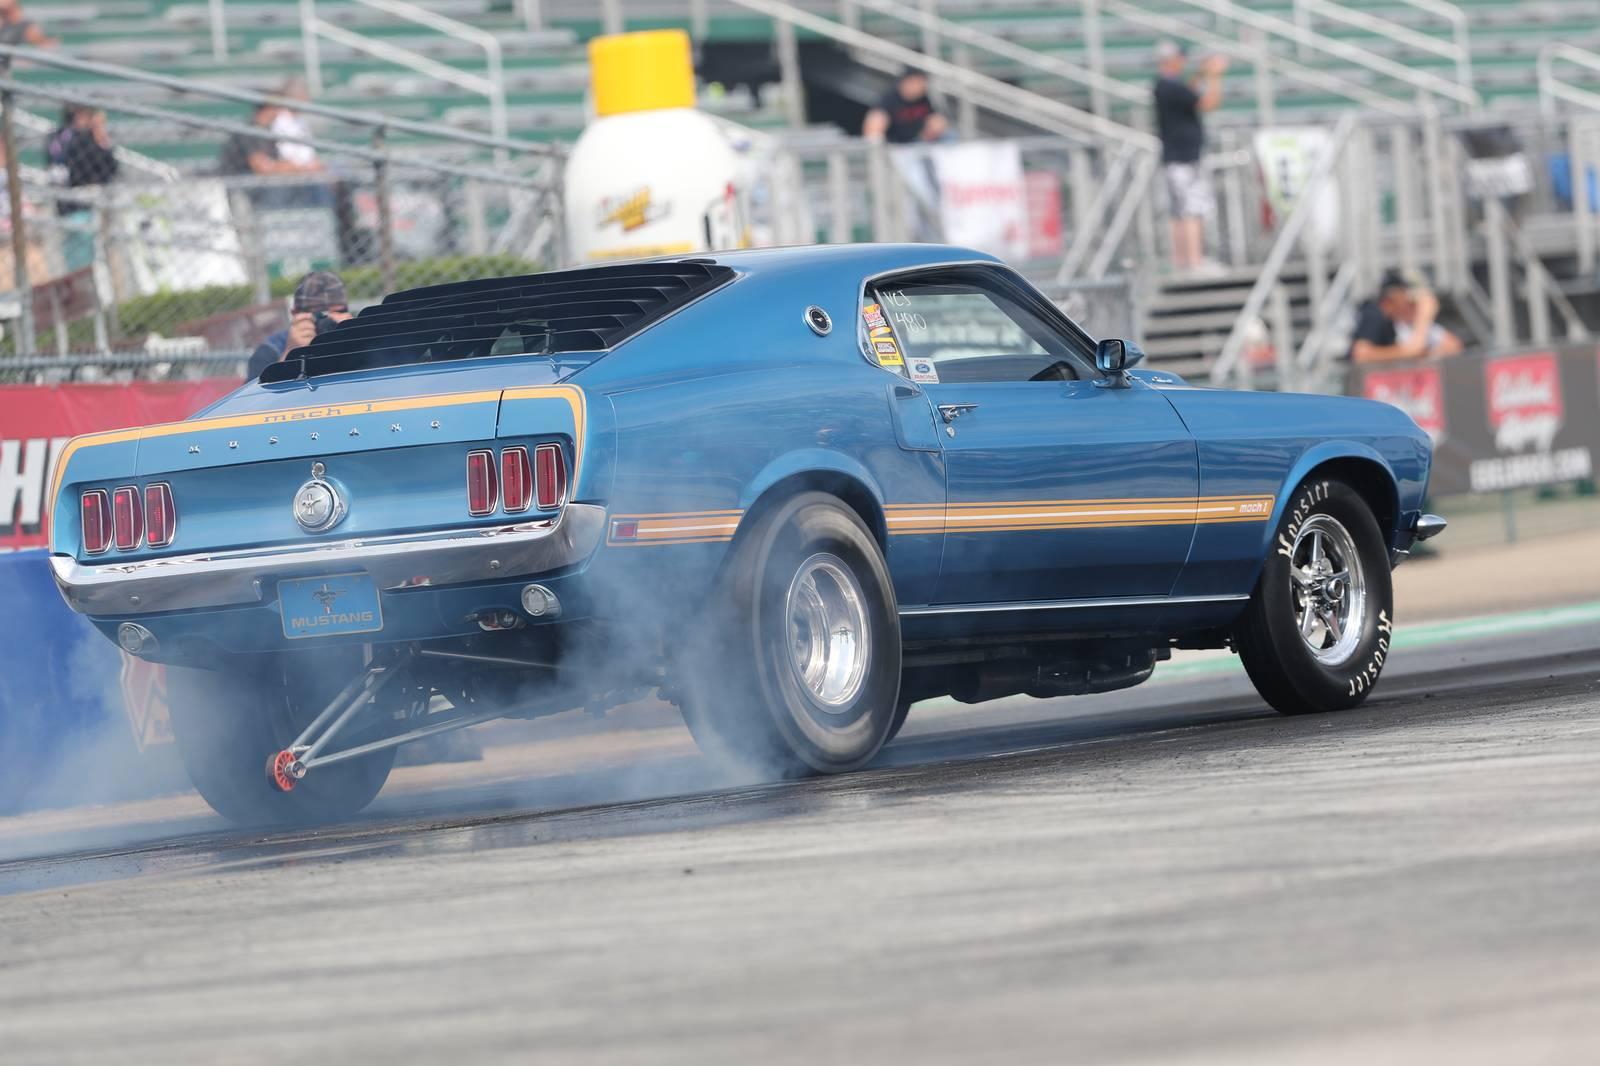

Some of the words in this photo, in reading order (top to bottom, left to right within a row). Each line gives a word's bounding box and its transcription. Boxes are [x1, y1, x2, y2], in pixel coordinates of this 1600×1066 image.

[895, 312, 927, 333] 480
[263, 407, 342, 422] mach
[188, 419, 442, 454] MUSTANG
[1239, 501, 1263, 513] mach
[291, 611, 374, 629] MUSTANG
